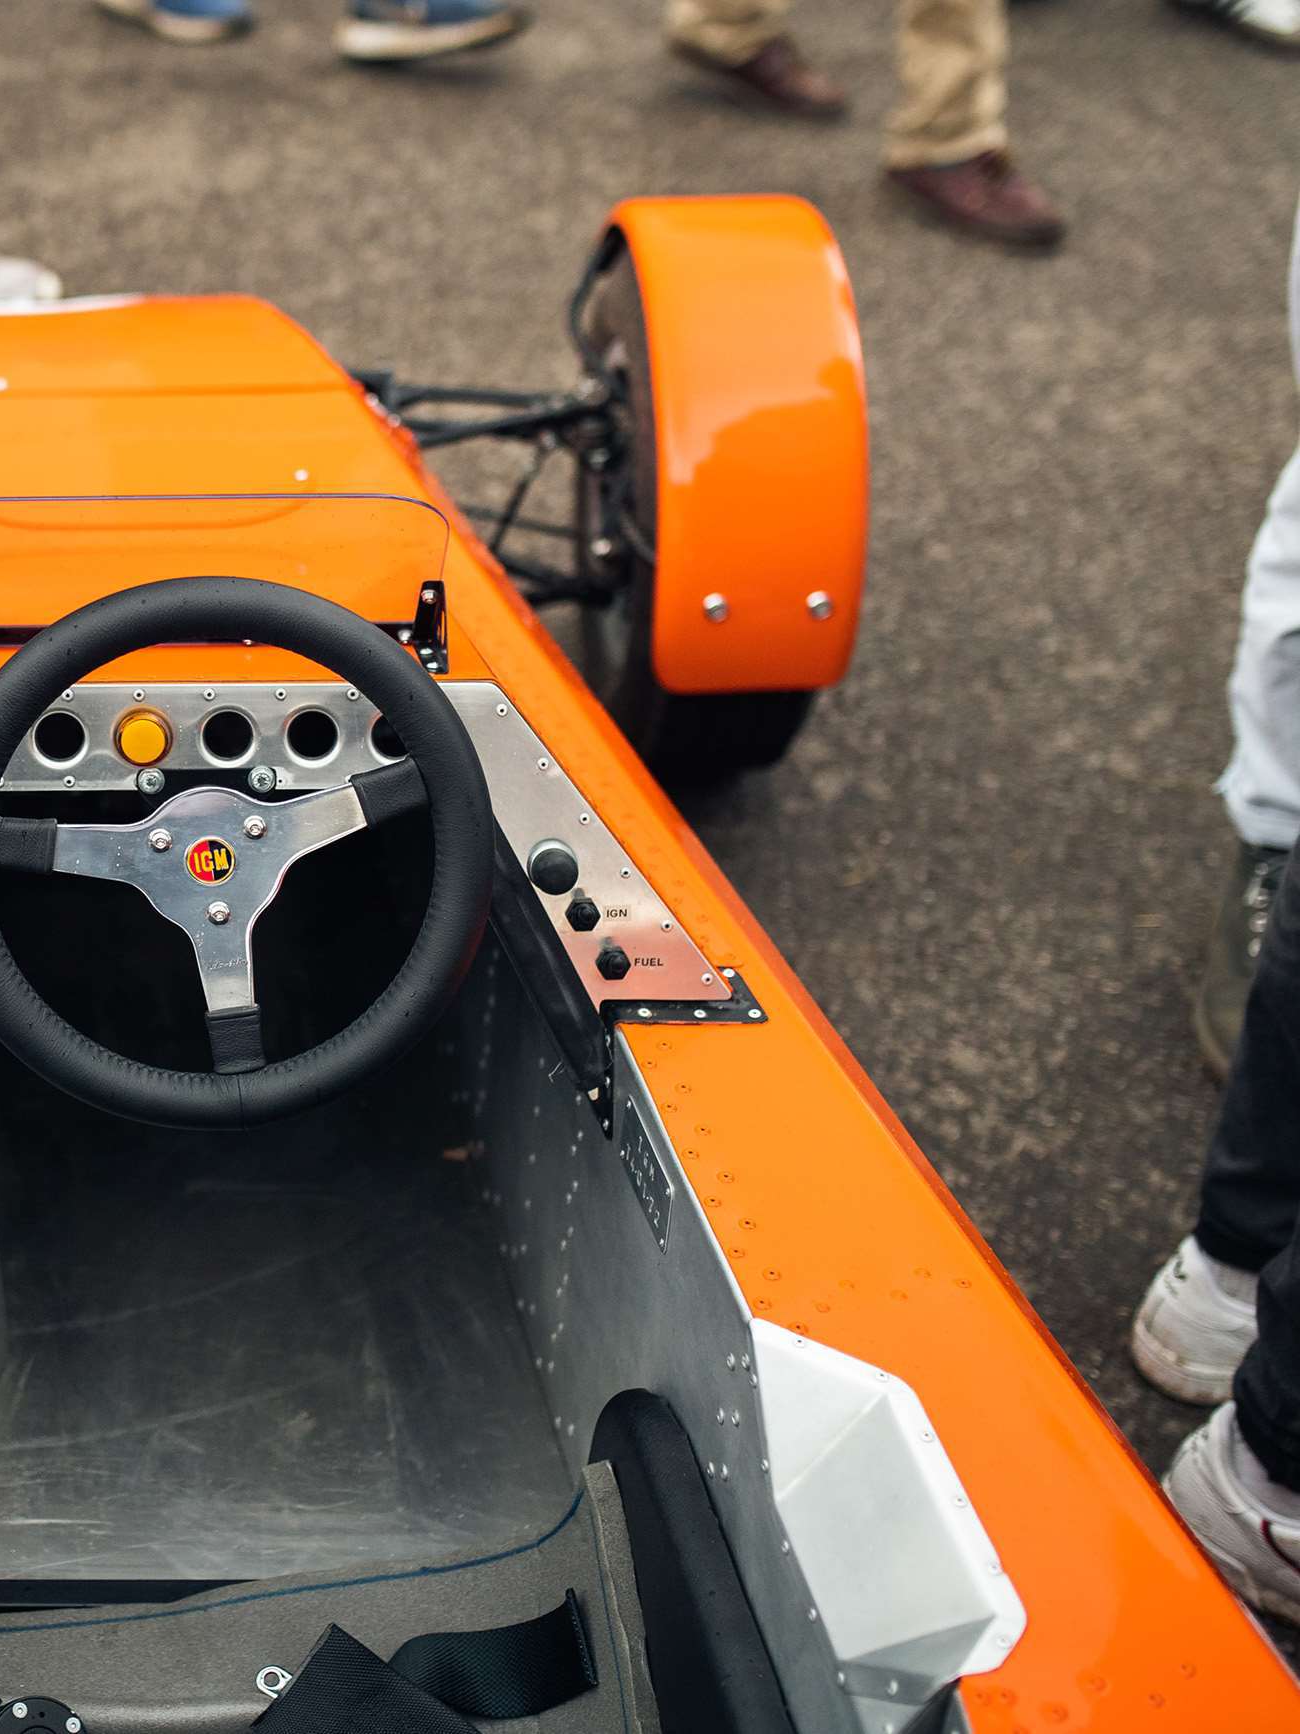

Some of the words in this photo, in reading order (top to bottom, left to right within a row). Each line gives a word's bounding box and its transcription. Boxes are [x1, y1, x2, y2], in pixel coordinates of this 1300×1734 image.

[194, 848, 230, 874] IGM
[606, 909, 628, 918] IGN
[634, 958, 664, 967] FUEL
